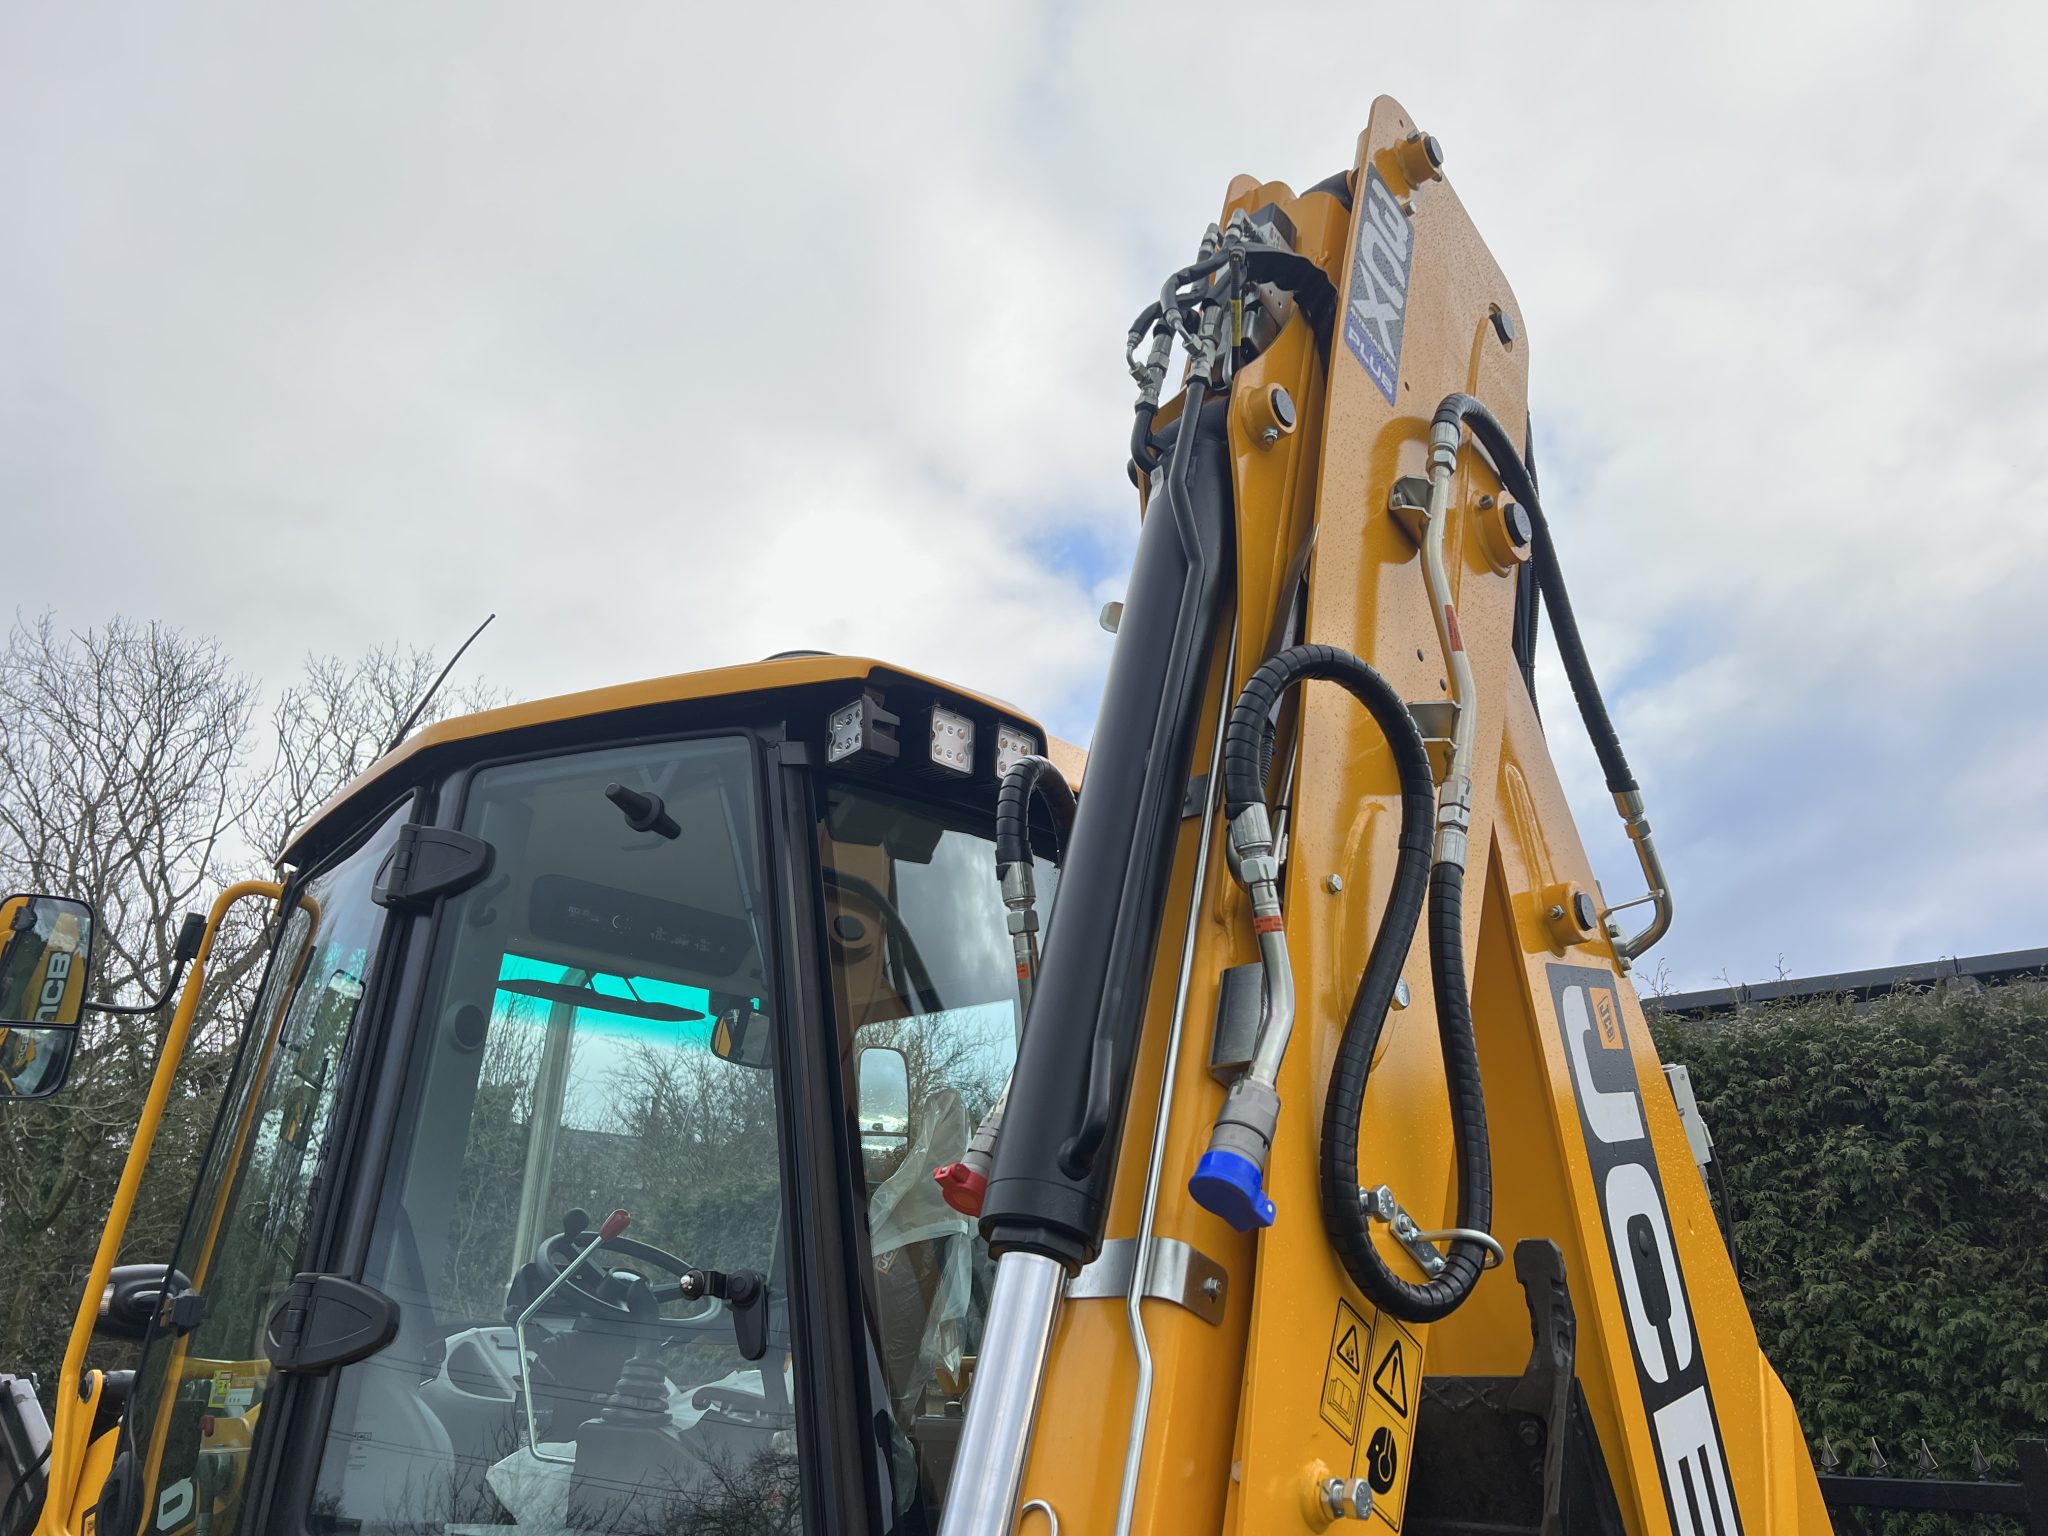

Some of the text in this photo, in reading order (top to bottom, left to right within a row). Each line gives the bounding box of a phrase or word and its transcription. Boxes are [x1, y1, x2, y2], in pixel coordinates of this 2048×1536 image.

[1352, 178, 1409, 364] 3CX
[1348, 325, 1393, 394] PLUS
[1350, 305, 1397, 372] SITEMASTER
[1599, 1002, 1615, 1041] JCB
[1562, 985, 1738, 1536] JCB
